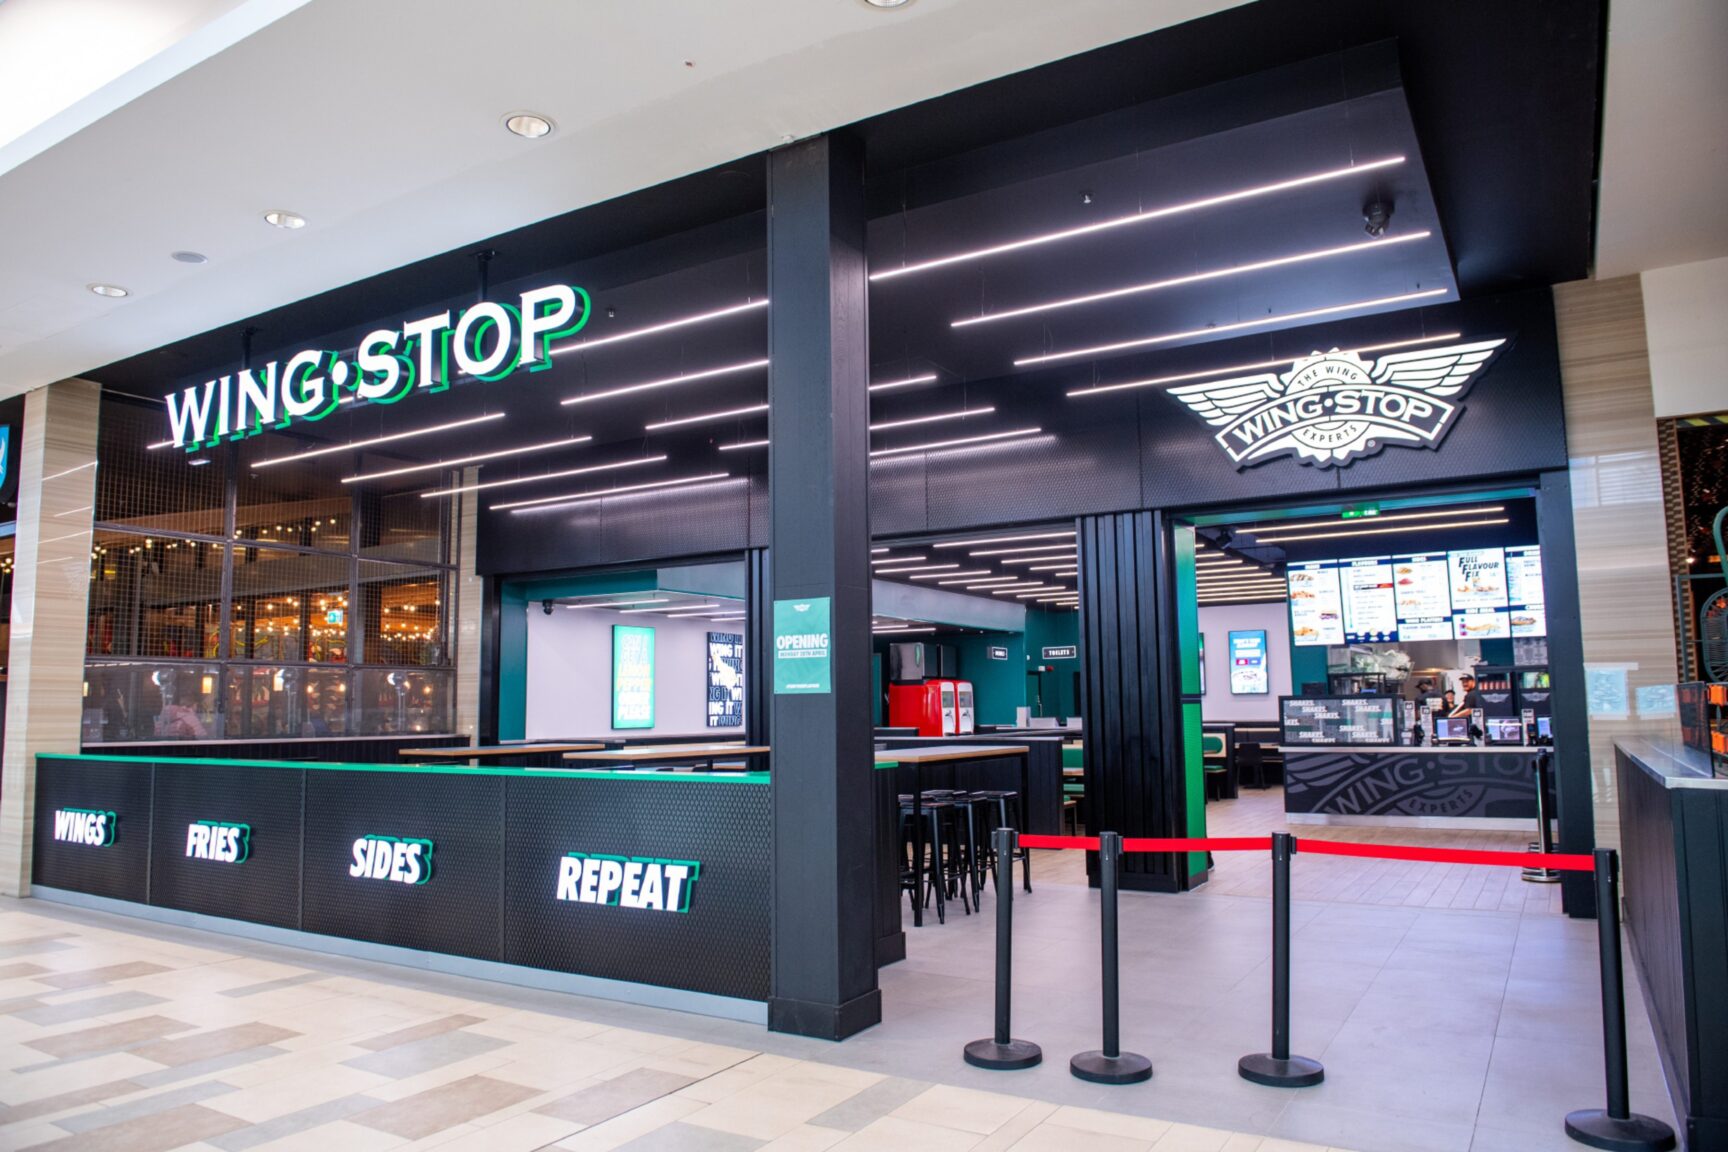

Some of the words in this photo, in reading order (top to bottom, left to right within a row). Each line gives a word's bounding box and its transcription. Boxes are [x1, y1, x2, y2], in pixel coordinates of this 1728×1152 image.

[1298, 369, 1318, 387] THE
[1326, 366, 1358, 381] WING
[1302, 424, 1357, 443] EXPERTS
[1459, 556, 1477, 567] FULL
[1462, 562, 1499, 574] FLAVOUR
[1465, 571, 1479, 582] FIX
[776, 633, 828, 649] OPENING
[1408, 788, 1473, 815] EXPERTS
[54, 810, 107, 846] WINGS
[186, 824, 240, 862] FRIES
[350, 838, 422, 884] SIDES
[557, 856, 688, 912] REPEAT
